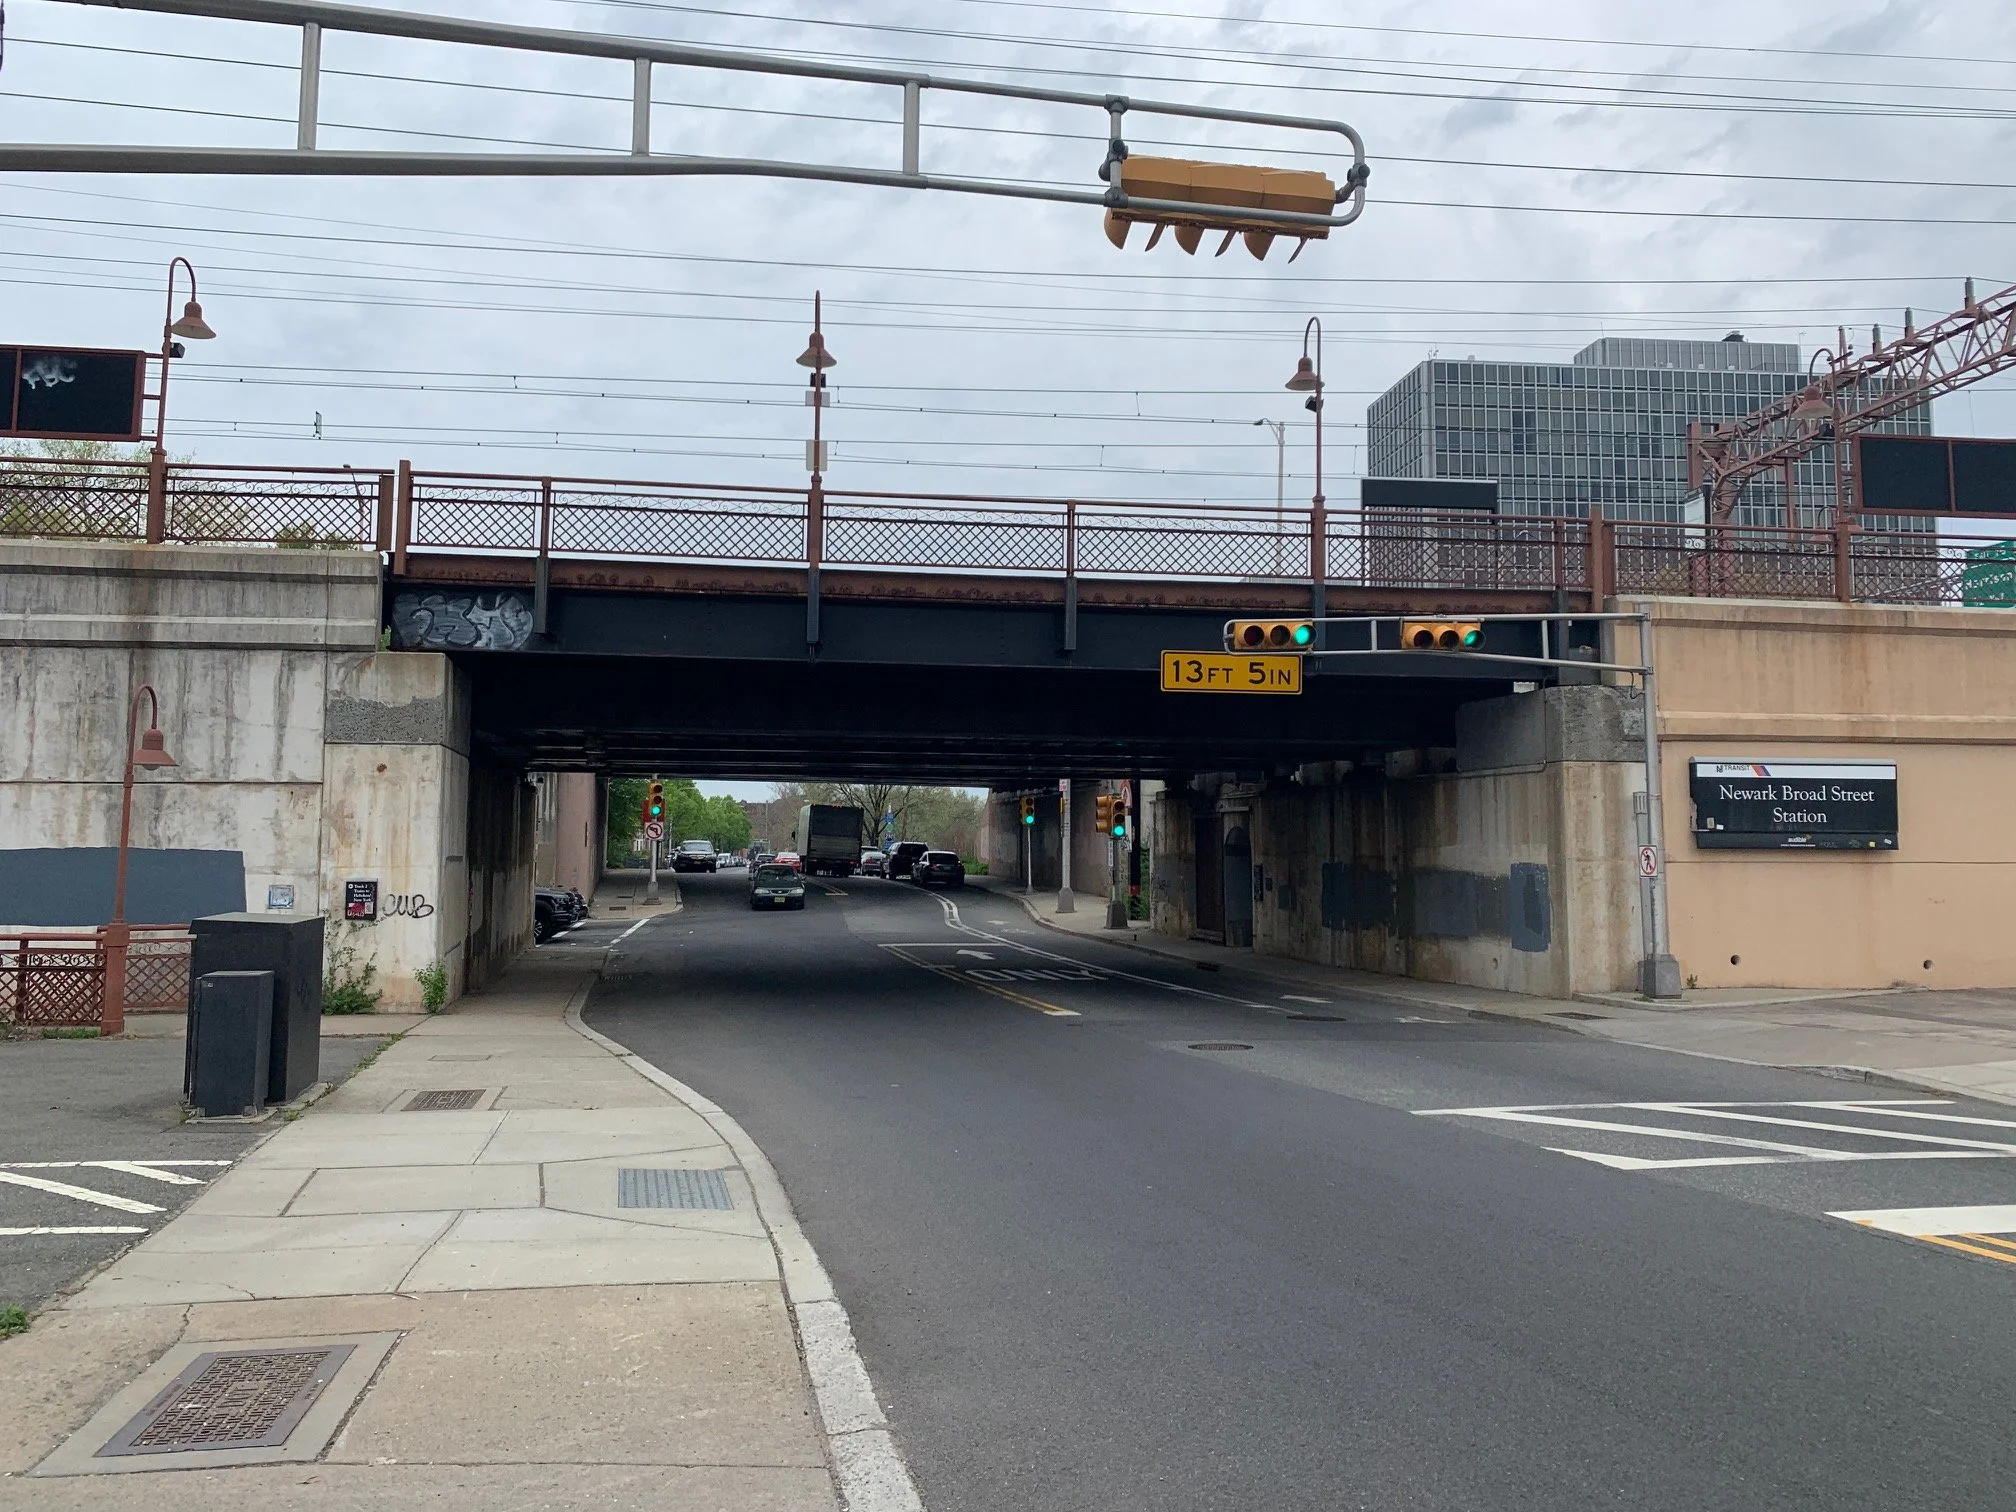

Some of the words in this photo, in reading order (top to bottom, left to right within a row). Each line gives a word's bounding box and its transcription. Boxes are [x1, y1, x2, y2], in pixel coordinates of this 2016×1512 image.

[1248, 661, 1291, 685] 5IN
[1719, 784, 1778, 800] Newark
[1782, 785, 1827, 801] Broad
[1831, 786, 1875, 802] Street
[1773, 807, 1828, 823] Station
[965, 969, 1109, 981] ONLY
